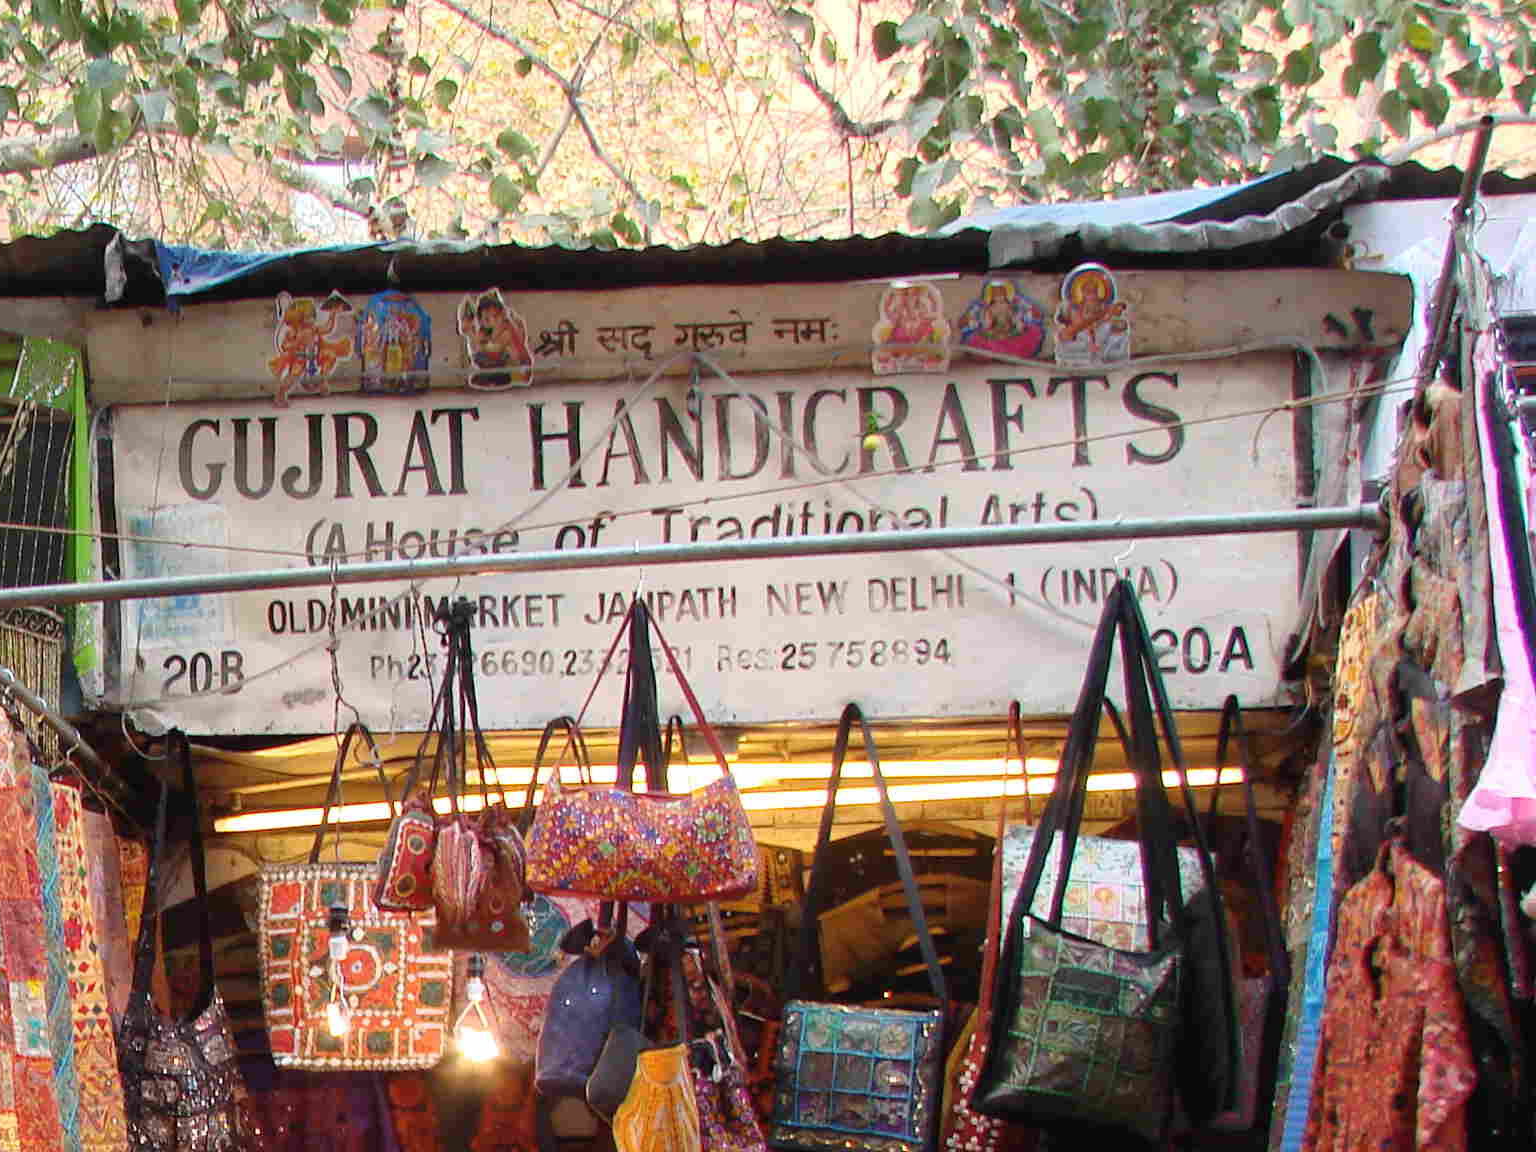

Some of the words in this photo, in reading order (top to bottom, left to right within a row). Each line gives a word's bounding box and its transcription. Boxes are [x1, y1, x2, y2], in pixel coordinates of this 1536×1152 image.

[178, 407, 480, 500] GUJRAT
[525, 371, 1185, 491] HANDICRAFTS
[366, 520, 519, 564] House
[554, 509, 616, 549] of
[651, 494, 948, 546] Traditional
[980, 486, 1100, 526] Arts)
[267, 599, 327, 635] OLD
[423, 594, 565, 628] MRKET
[766, 580, 848, 616] NEW
[868, 573, 966, 614] DELHI
